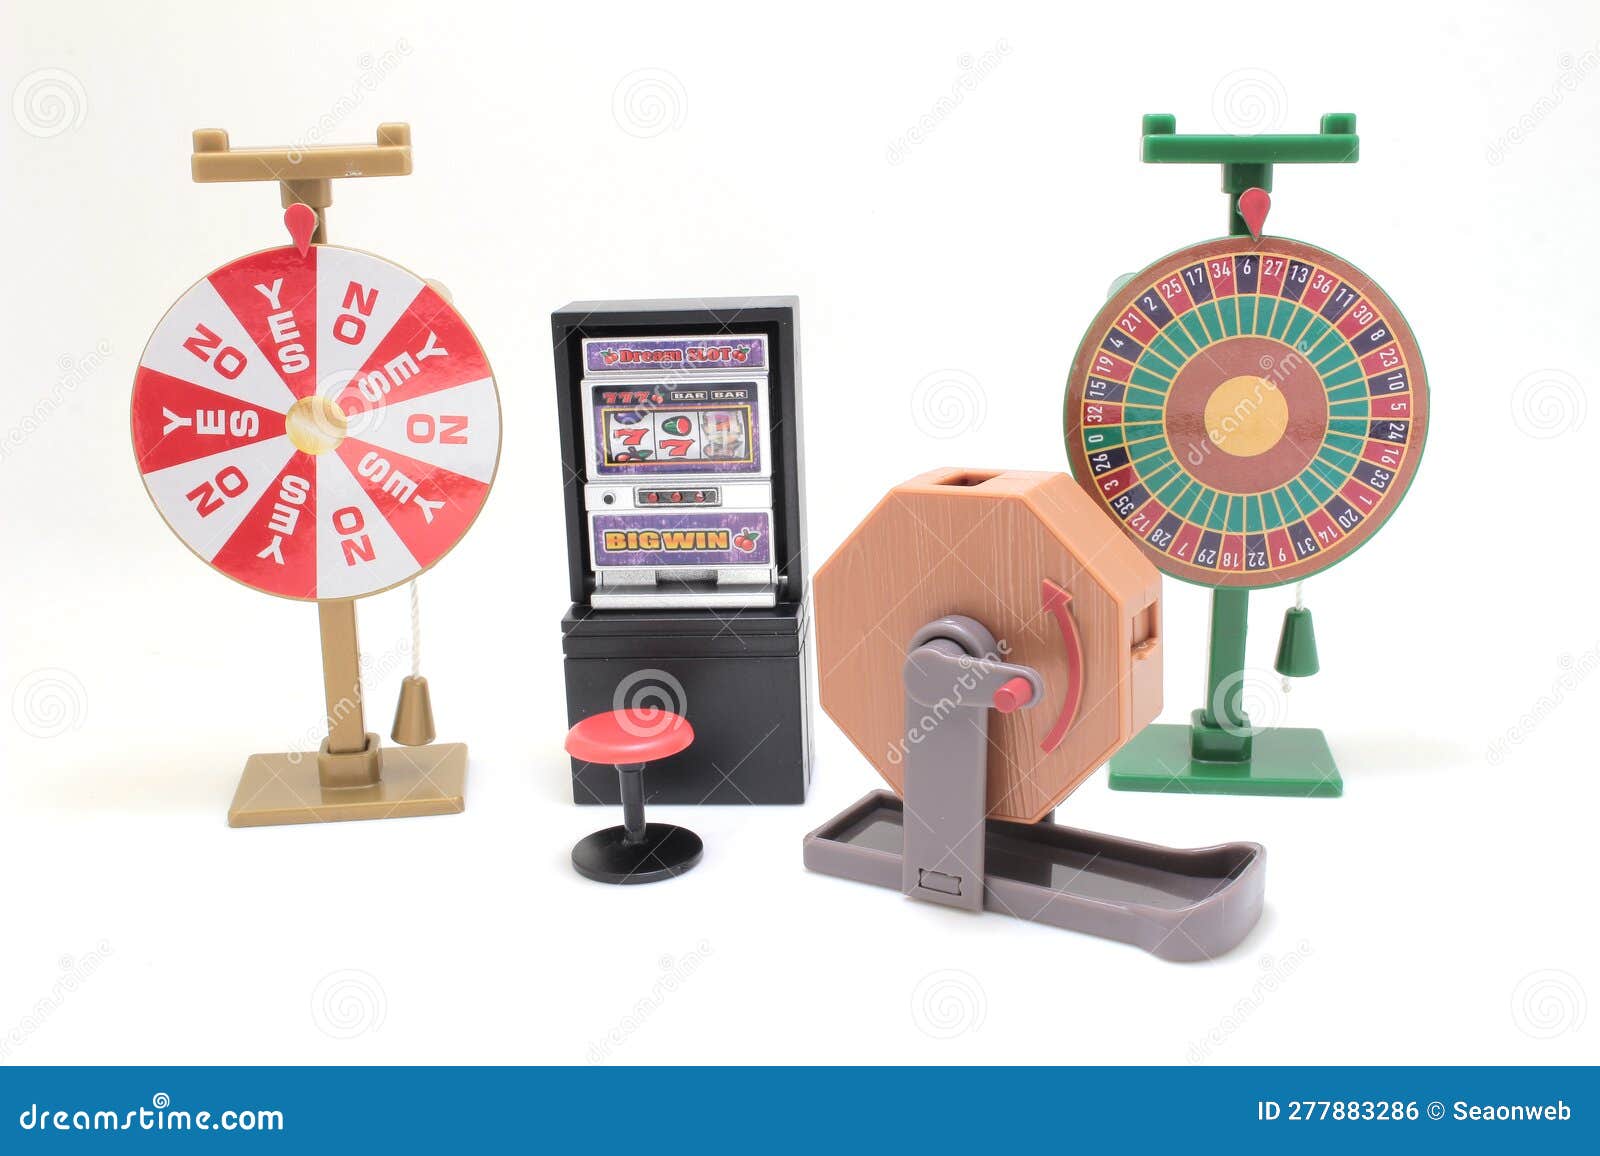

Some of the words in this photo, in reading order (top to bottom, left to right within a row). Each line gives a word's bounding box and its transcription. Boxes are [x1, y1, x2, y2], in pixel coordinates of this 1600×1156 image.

[1212, 261, 1231, 279] 34
[1243, 258, 1251, 275] 6
[1263, 259, 1283, 277] 27
[1291, 265, 1309, 283] 13
[1186, 267, 1203, 286] 17
[1312, 274, 1333, 294] 36
[1161, 278, 1182, 299] 25
[1335, 287, 1355, 308] 11
[332, 280, 379, 345] NO
[1143, 296, 1158, 311] 2
[1121, 312, 1142, 333] 21
[1352, 305, 1374, 325] 30
[253, 277, 310, 374] YES
[1370, 328, 1386, 342] 8
[182, 322, 248, 380] NO
[1109, 336, 1124, 349] 4
[619, 349, 683, 363] Dream
[686, 347, 732, 362] SLOT
[1096, 356, 1114, 373] 19
[1379, 348, 1399, 368] 23
[357, 330, 448, 402] YES
[1089, 380, 1107, 397] 15
[1387, 372, 1405, 391] 10
[673, 392, 706, 400] BAR
[714, 391, 746, 399] BAR
[1087, 406, 1103, 423] 32
[1390, 402, 1407, 411] 5
[162, 409, 259, 437] YES
[406, 413, 468, 445] NO
[1387, 422, 1406, 440] 24
[613, 428, 650, 446] 7
[1088, 434, 1104, 443] 0
[659, 438, 696, 457] 7
[1380, 448, 1400, 465] 16
[1092, 453, 1111, 472] 26
[357, 451, 446, 523] YES
[1104, 479, 1119, 490] 3
[1369, 469, 1390, 489] 33
[185, 465, 249, 518] NO
[1359, 495, 1373, 506] 1
[1114, 495, 1135, 515] 35
[257, 475, 310, 565] YES
[1131, 512, 1150, 532] 12
[1338, 508, 1359, 529] 20
[332, 506, 376, 566] NO
[604, 530, 662, 552] BIG
[662, 530, 730, 551] WIN
[1151, 528, 1172, 547] 28
[1318, 524, 1338, 543] 14
[1177, 542, 1188, 557] 7
[1278, 547, 1287, 562] 9
[1296, 537, 1316, 555] 31
[1197, 548, 1217, 565] 29
[1223, 552, 1239, 568] 18
[1247, 551, 1266, 568] 22
